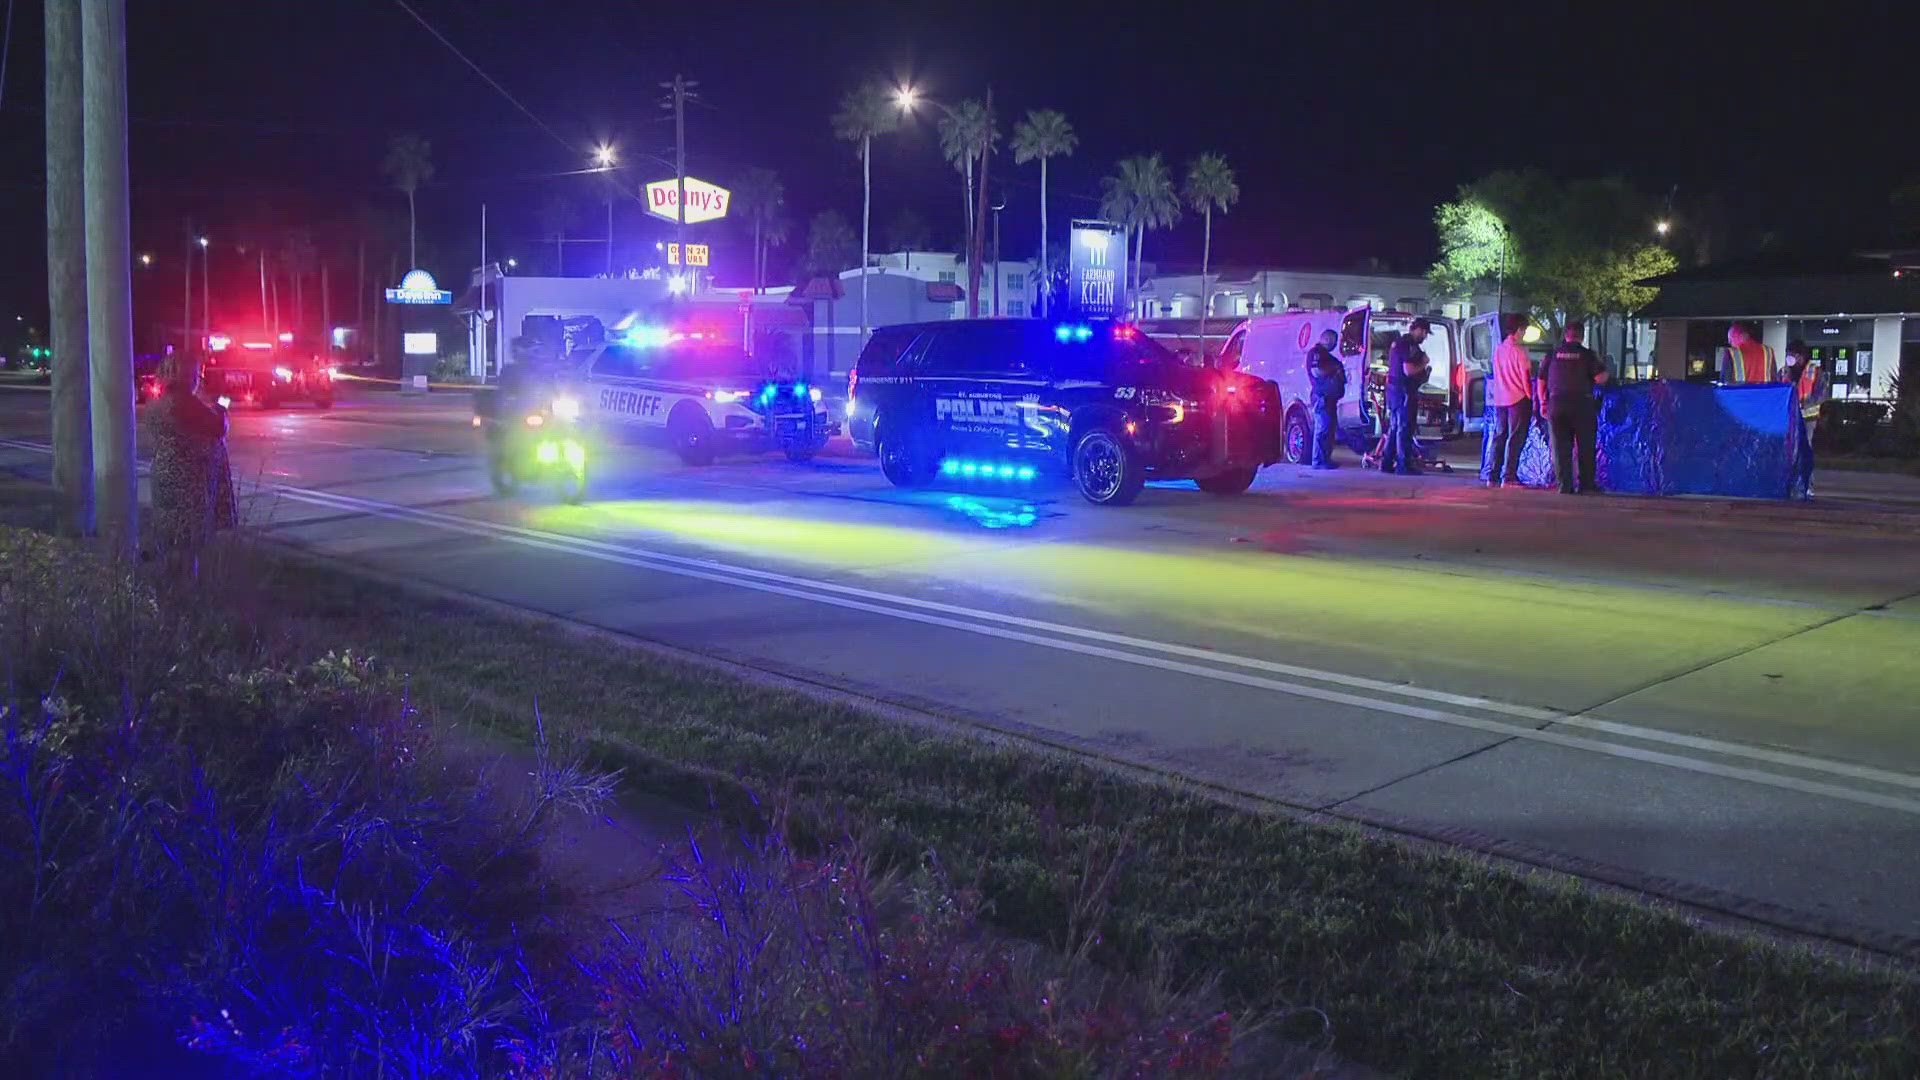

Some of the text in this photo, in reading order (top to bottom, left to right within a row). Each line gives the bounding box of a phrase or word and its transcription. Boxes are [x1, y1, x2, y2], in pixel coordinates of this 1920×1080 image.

[670, 246, 706, 255] ON 24
[674, 255, 703, 264] HURS
[1081, 281, 1114, 306] KCHN
[599, 388, 662, 417] SHERIFF
[935, 398, 1019, 426] POLICE
